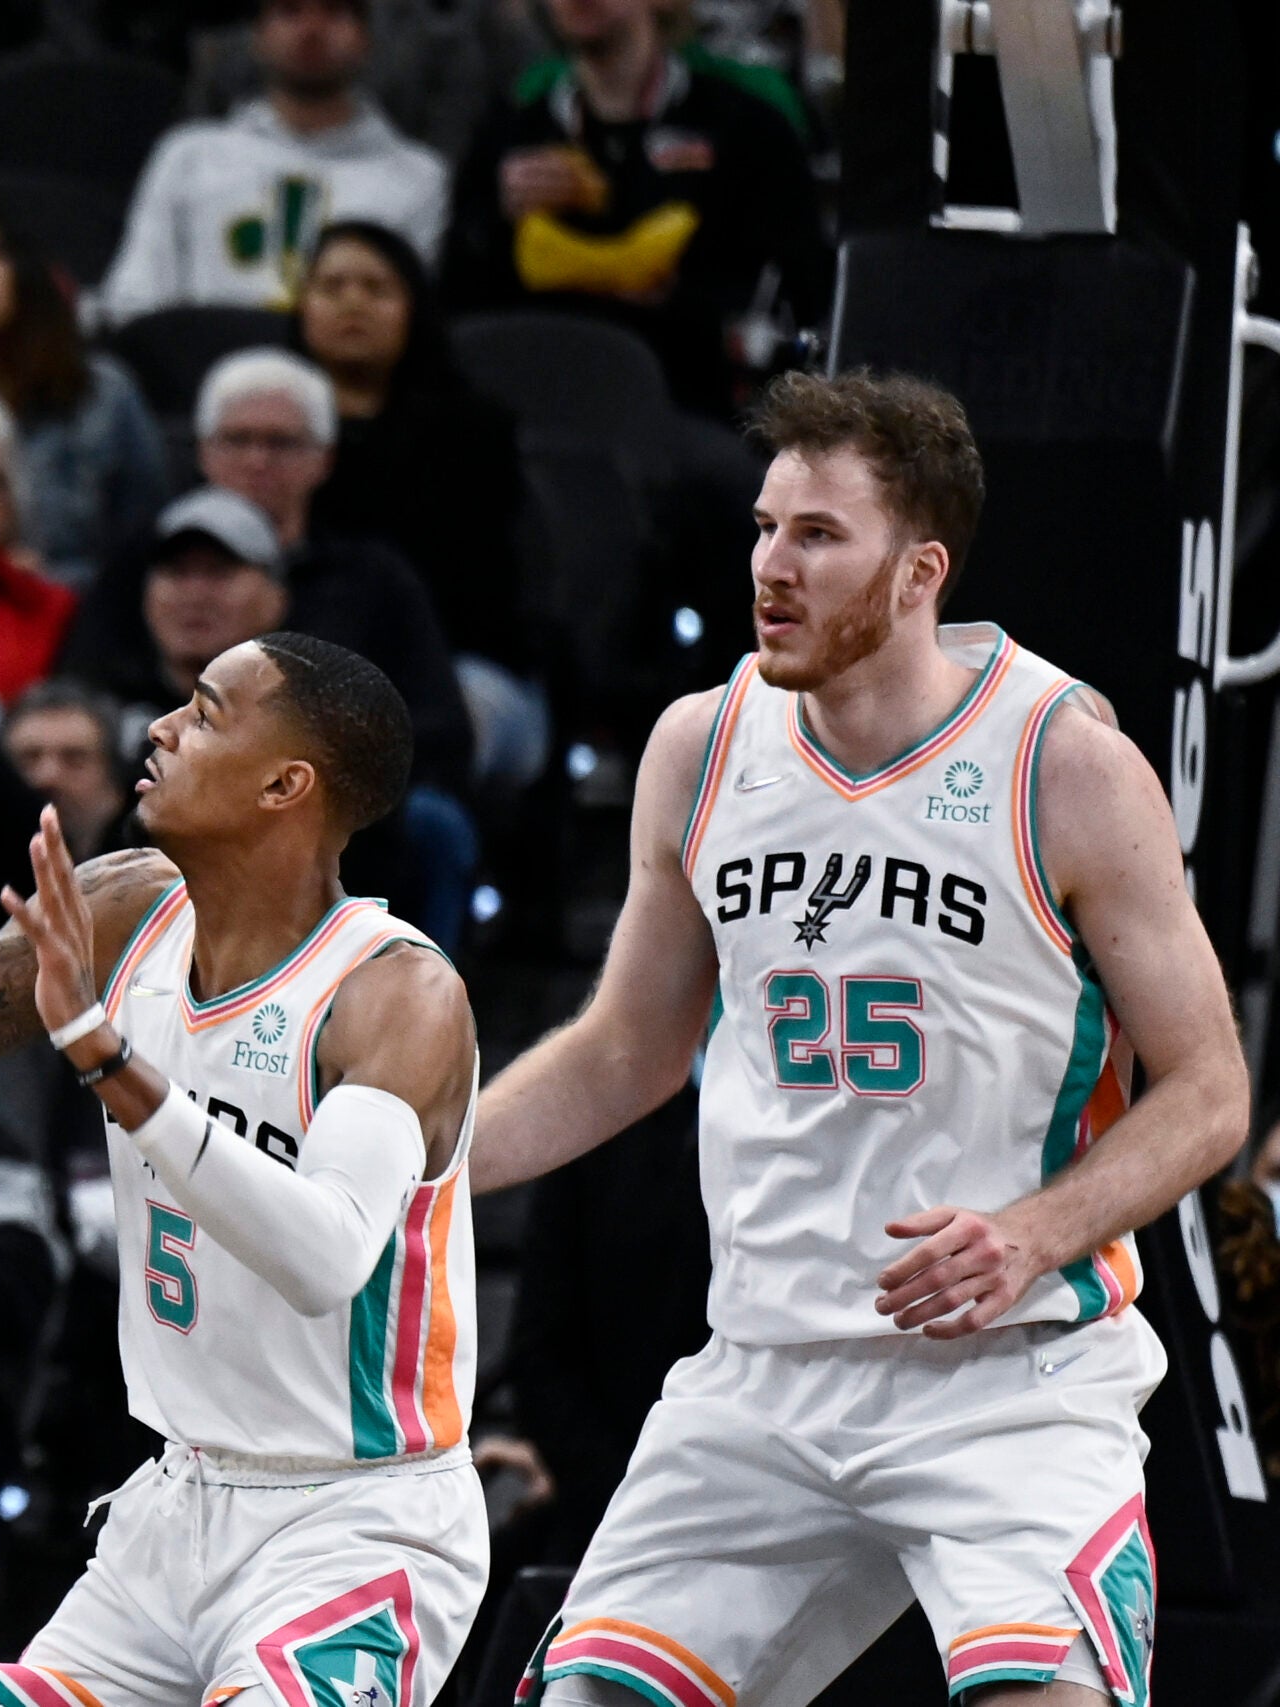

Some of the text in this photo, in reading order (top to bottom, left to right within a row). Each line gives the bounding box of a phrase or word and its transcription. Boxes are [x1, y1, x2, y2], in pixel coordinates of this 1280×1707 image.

[924, 795, 993, 824] Frost
[716, 851, 988, 952] SPURS
[231, 1040, 291, 1076] Frost
[764, 969, 926, 1098] 25
[144, 1198, 200, 1336] 5
